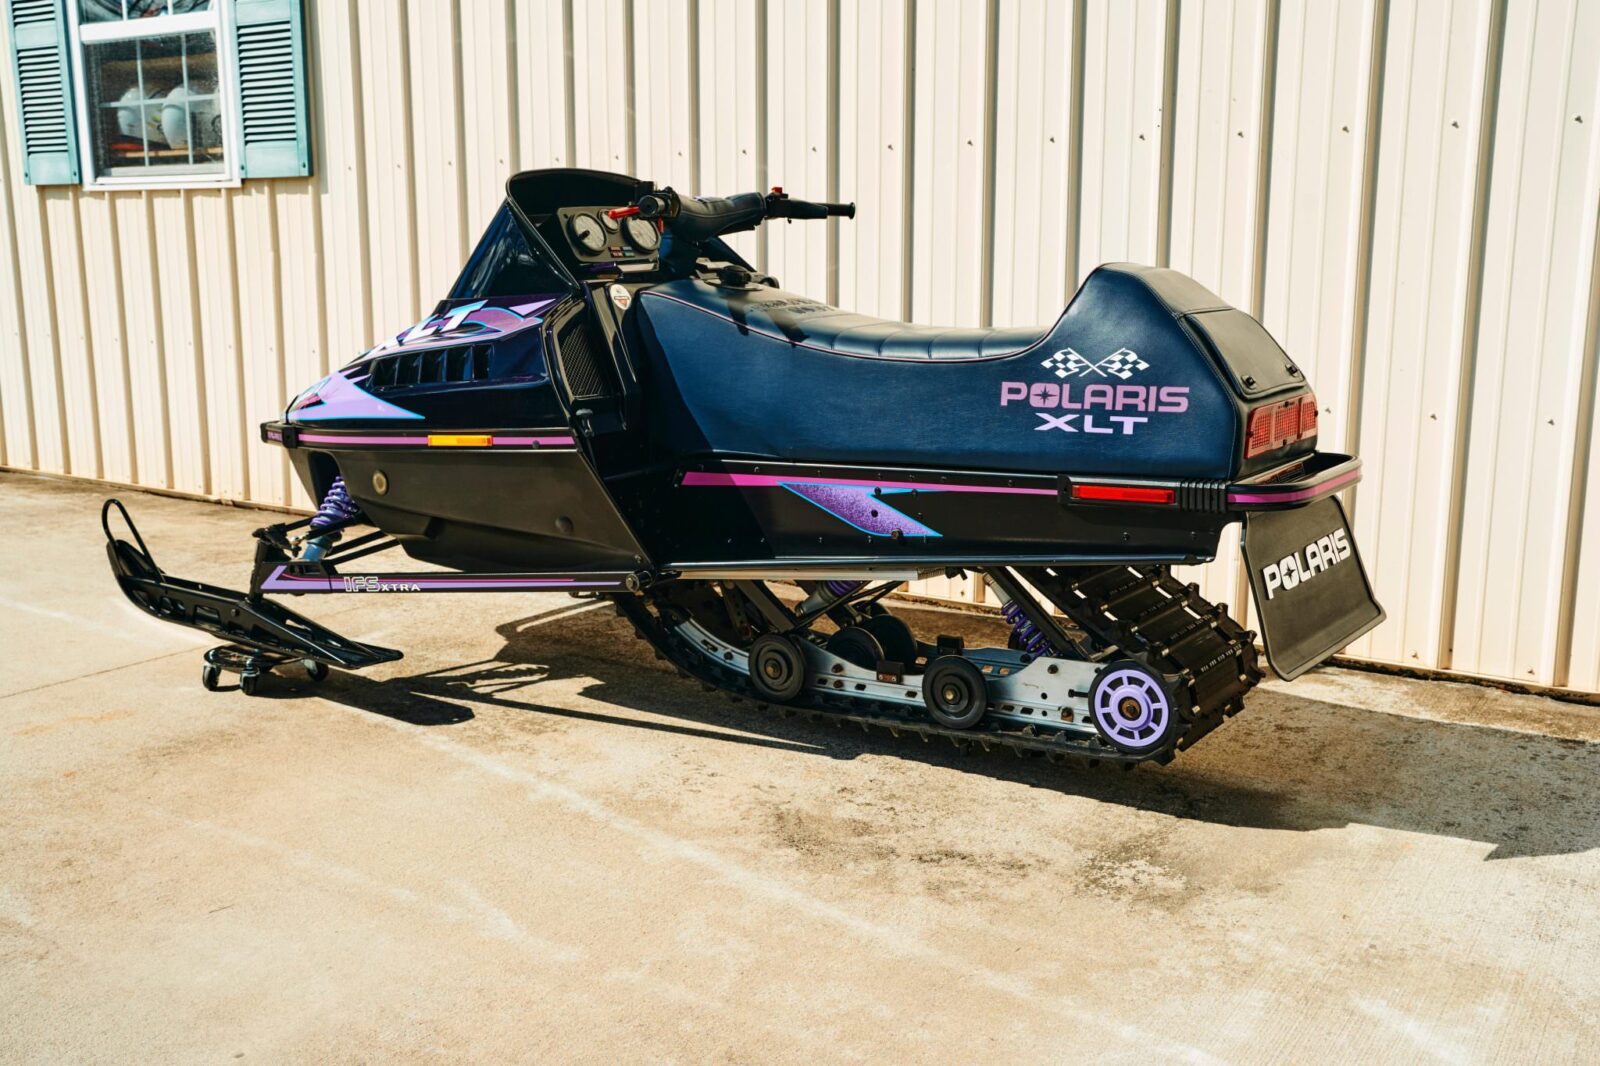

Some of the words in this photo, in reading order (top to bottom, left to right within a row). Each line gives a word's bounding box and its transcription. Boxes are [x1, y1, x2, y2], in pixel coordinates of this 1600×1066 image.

[1000, 381, 1190, 413] POLARIS
[1033, 412, 1149, 435] XLT
[1262, 527, 1351, 600] POLARIS
